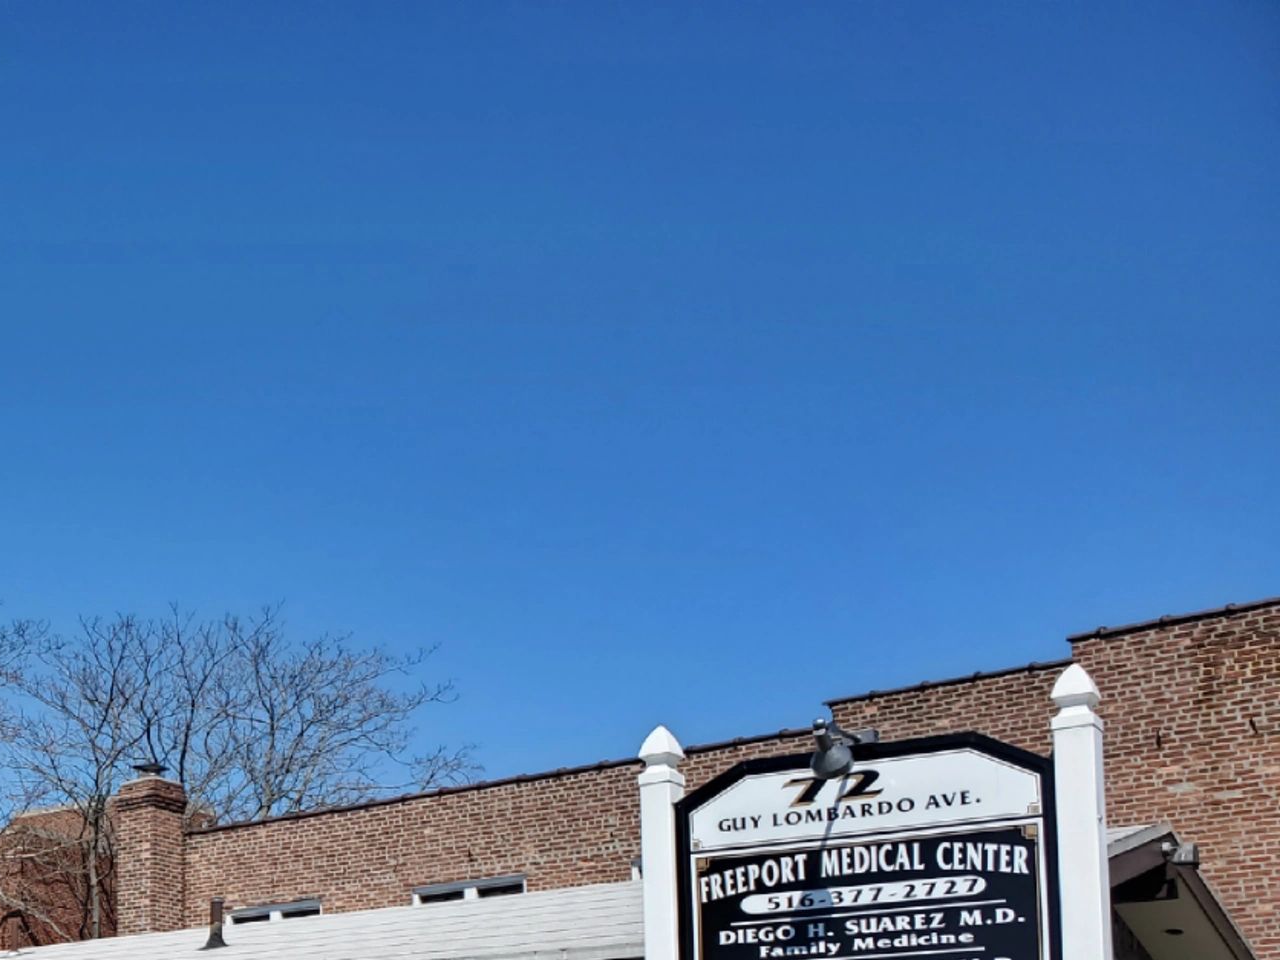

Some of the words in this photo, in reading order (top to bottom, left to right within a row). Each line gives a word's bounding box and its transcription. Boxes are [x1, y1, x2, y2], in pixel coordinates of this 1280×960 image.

[781, 769, 884, 808] 72
[718, 815, 763, 832] GUY
[773, 797, 915, 828] LOMBARDO
[925, 790, 982, 810] AVE.
[699, 854, 807, 903] FREEPORT
[821, 842, 924, 878] MEDICAL
[936, 842, 1029, 875] CENTER
[767, 877, 979, 910] 516-377-2727
[719, 924, 795, 946] DIEGO
[807, 923, 834, 939] H.
[844, 913, 945, 935] SUAREZ
[959, 908, 1026, 926] M.D.
[759, 940, 841, 958] Family
[852, 930, 975, 952] Medicine
